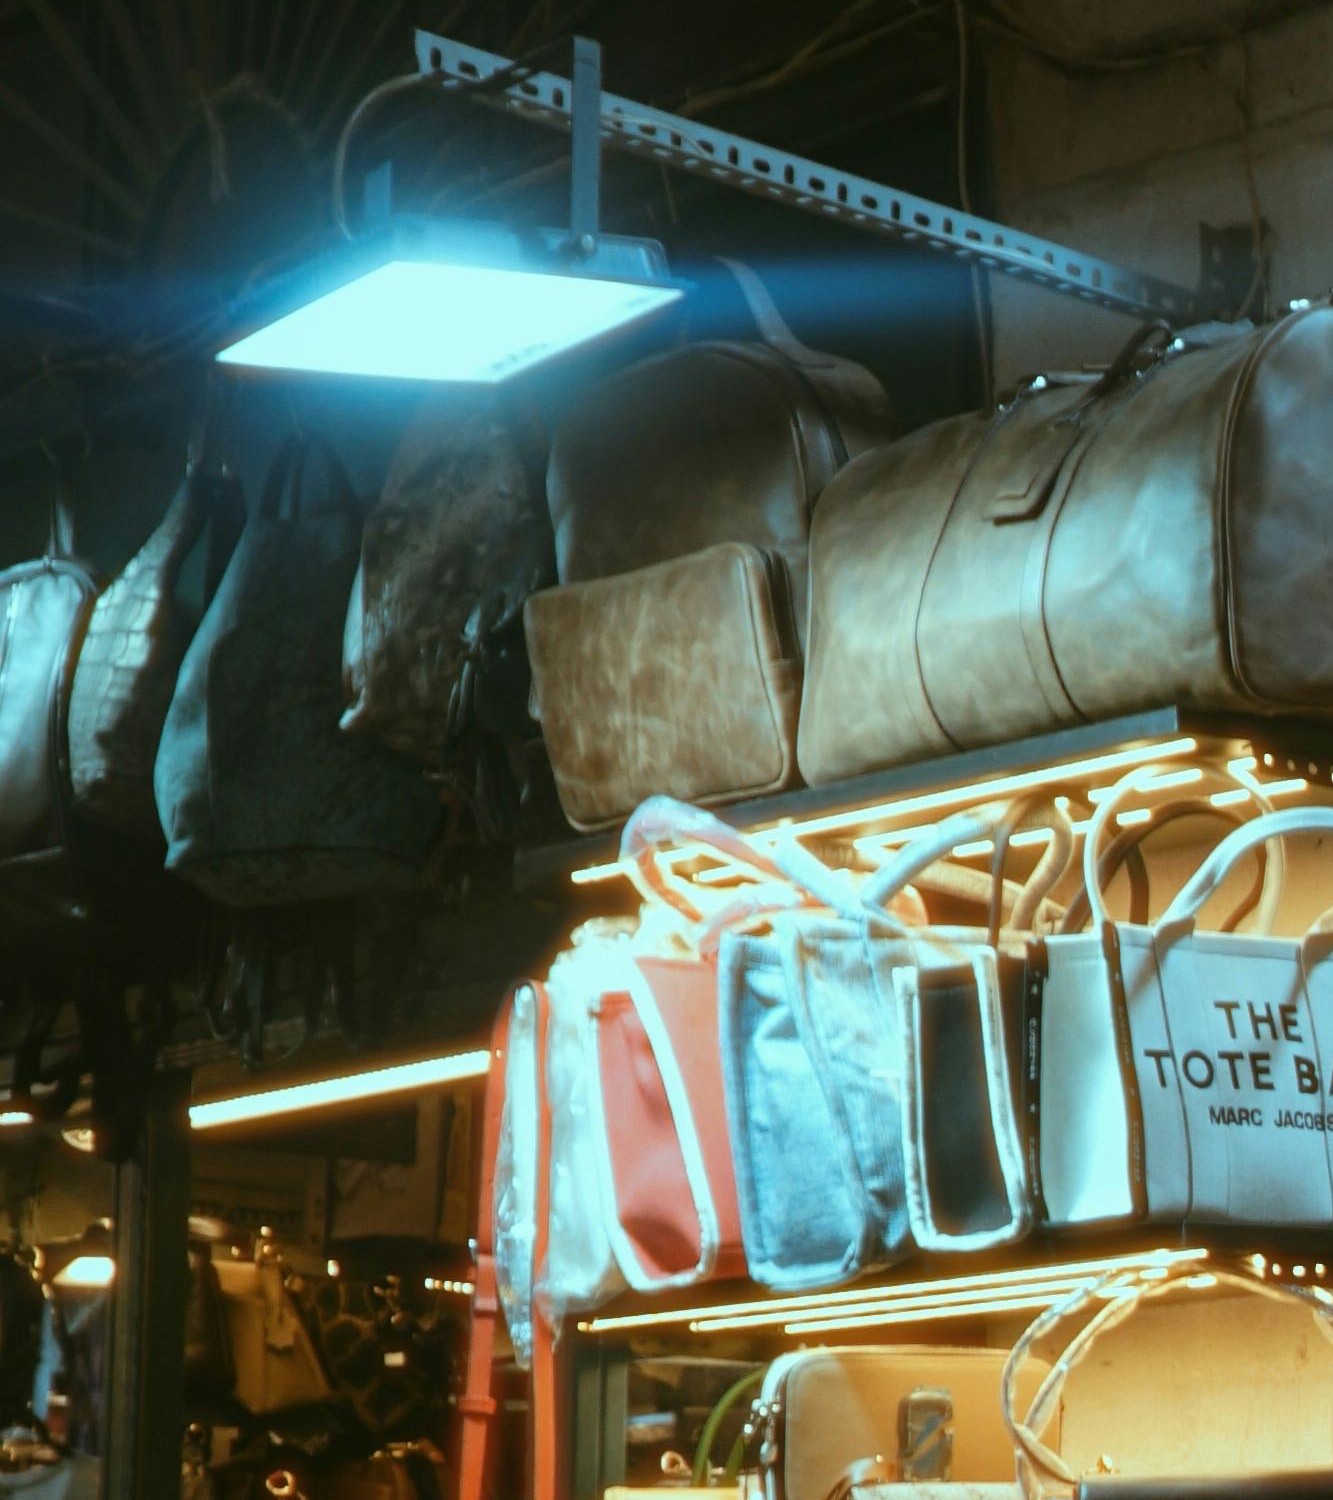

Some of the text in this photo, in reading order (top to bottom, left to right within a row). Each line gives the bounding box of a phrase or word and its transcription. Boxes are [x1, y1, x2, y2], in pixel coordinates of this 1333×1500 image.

[1215, 1001, 1303, 1042] THE
[1145, 1049, 1274, 1091] TOTE
[1209, 1106, 1263, 1126] MARC
